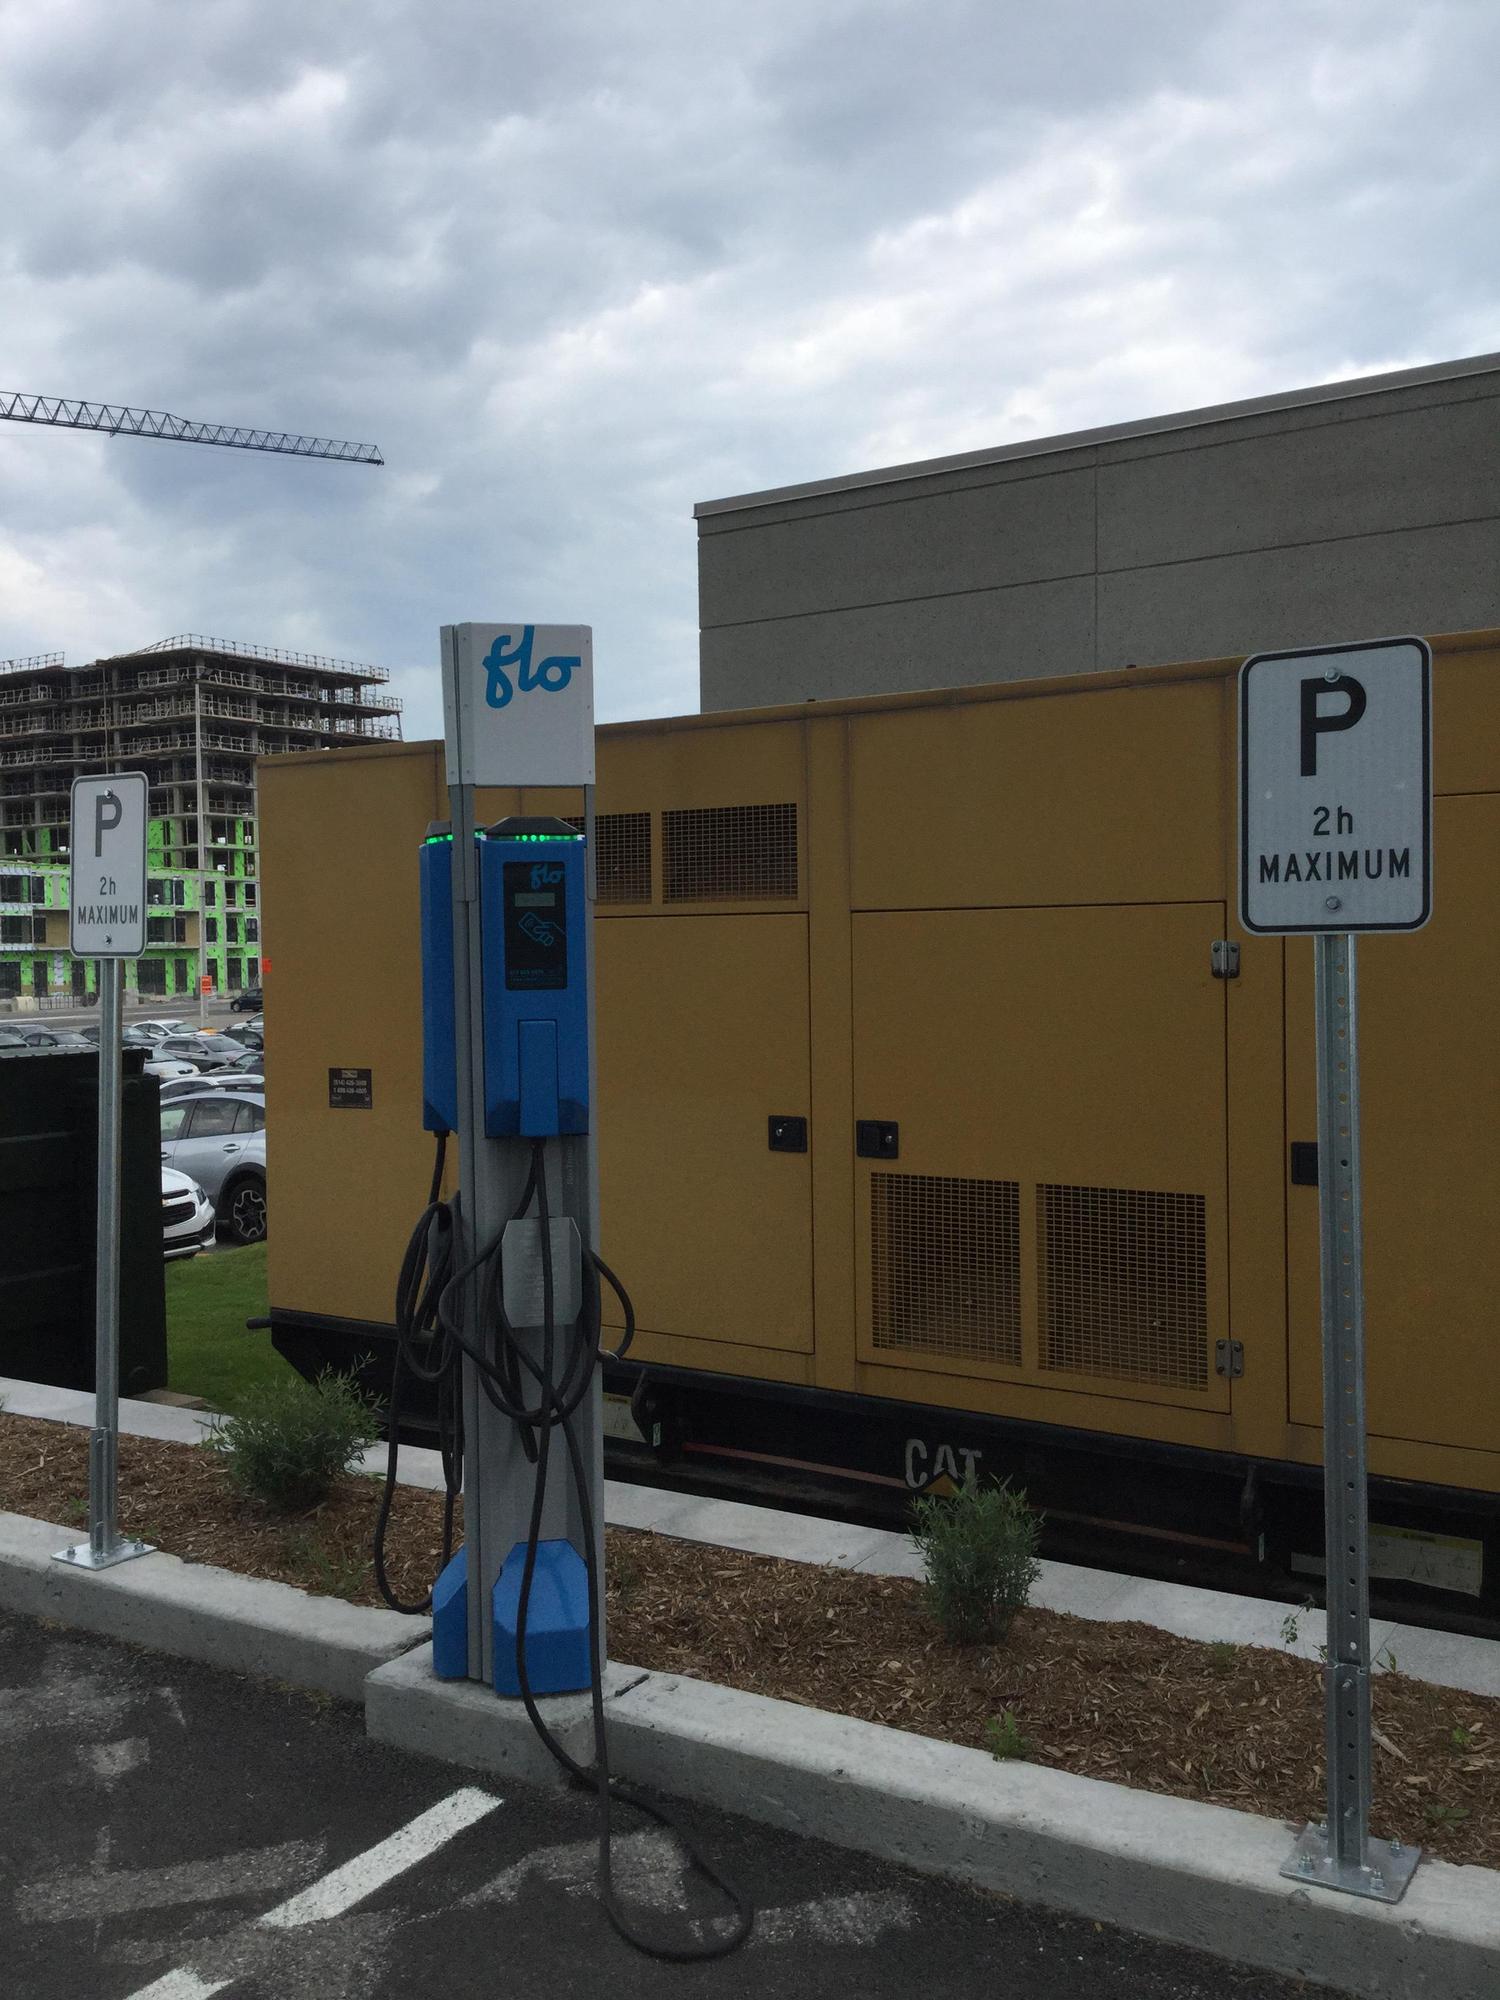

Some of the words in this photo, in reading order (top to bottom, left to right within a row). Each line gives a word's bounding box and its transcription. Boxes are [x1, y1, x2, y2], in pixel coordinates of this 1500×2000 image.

[482, 624, 582, 709] flo
[1300, 676, 1367, 777] P
[95, 794, 122, 858] P
[1312, 805, 1354, 836] 2h
[530, 863, 564, 891] flo
[1259, 848, 1410, 884] MAXIMUM
[99, 876, 117, 896] 2h
[77, 904, 138, 925] MAXIMUM
[905, 1438, 982, 1498] CAT
